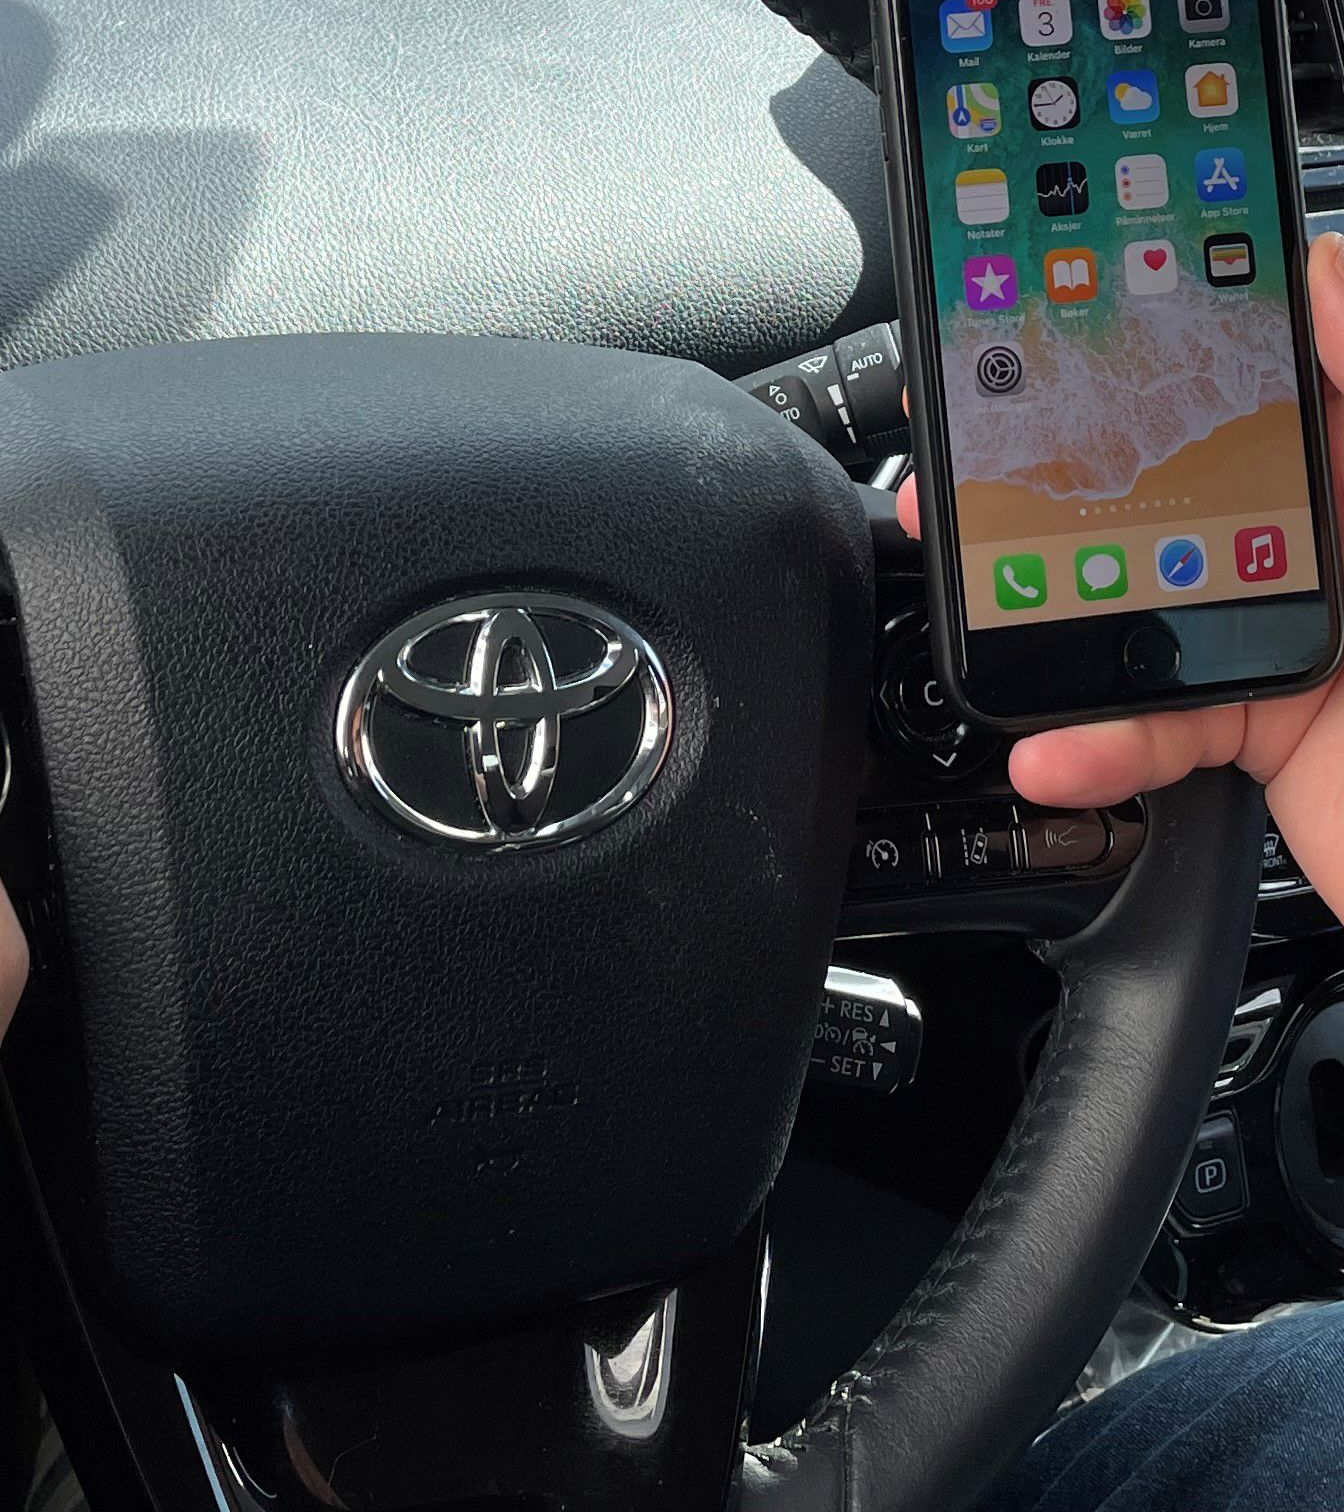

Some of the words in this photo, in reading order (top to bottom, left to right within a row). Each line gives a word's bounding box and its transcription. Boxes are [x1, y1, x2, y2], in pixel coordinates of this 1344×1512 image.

[1037, 11, 1055, 37] 3
[1114, 43, 1144, 56] Bilder
[1188, 37, 1226, 49] Kamera
[958, 57, 980, 68] Mail
[1027, 50, 1071, 63] Kalender
[1203, 122, 1229, 135] Hjem
[1041, 135, 1075, 147] Klokke
[967, 143, 989, 154] Kart
[1201, 208, 1220, 220] App
[1222, 206, 1249, 217] Store
[1051, 220, 1082, 233] Aksjer
[967, 228, 1006, 240] Notater
[851, 352, 883, 372] AUTO
[840, 999, 874, 1022] RES
[830, 1055, 866, 1077] SET
